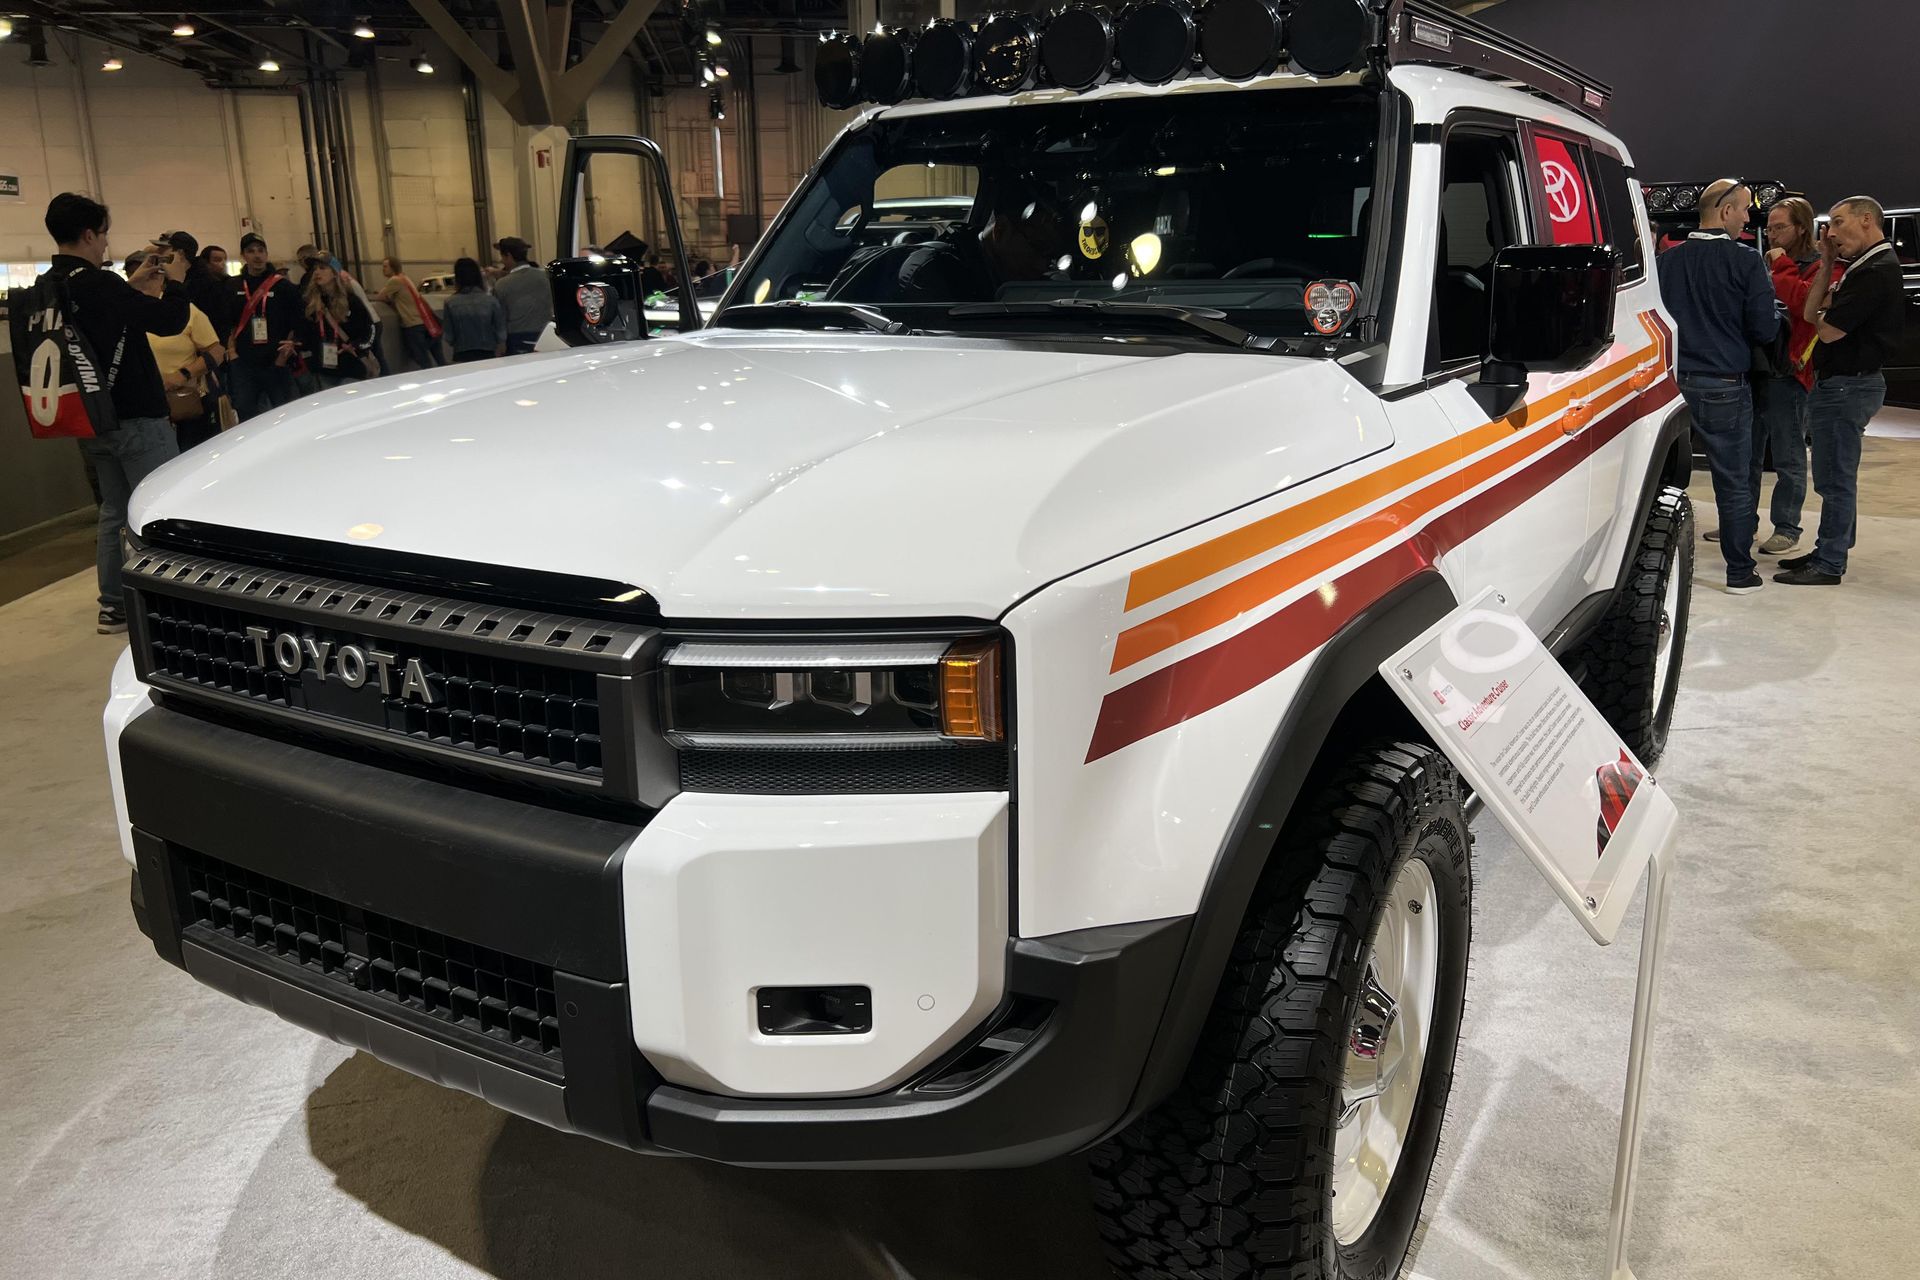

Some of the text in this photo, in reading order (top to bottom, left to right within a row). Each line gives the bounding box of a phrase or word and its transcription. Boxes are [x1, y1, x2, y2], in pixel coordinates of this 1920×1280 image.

[68, 343, 100, 393] OPTIMA
[246, 626, 434, 703] TOYOTA
[1458, 679, 1509, 731] Classic Adventure Cruiser
